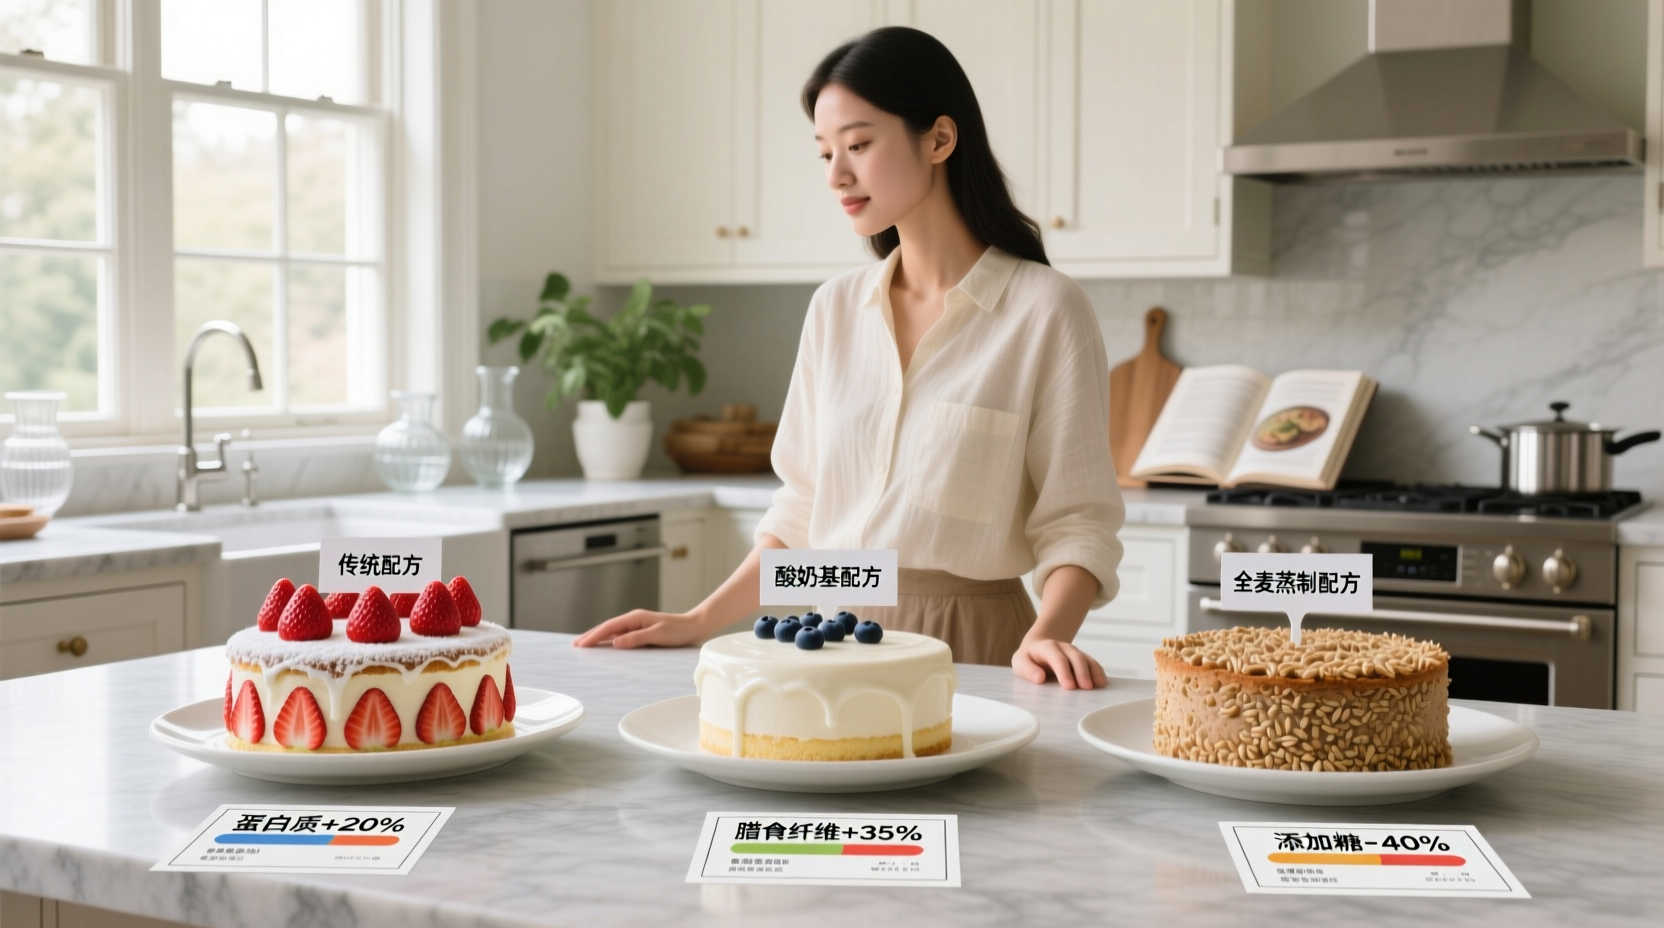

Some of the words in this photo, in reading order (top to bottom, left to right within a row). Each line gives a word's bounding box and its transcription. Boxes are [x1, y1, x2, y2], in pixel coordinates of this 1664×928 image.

[338, 553, 423, 576] 传统配方
[775, 564, 882, 588] 酸奶基配方
[1233, 570, 1362, 595] 全麦蒸制配方
[232, 814, 405, 833] 蛋白质+20%
